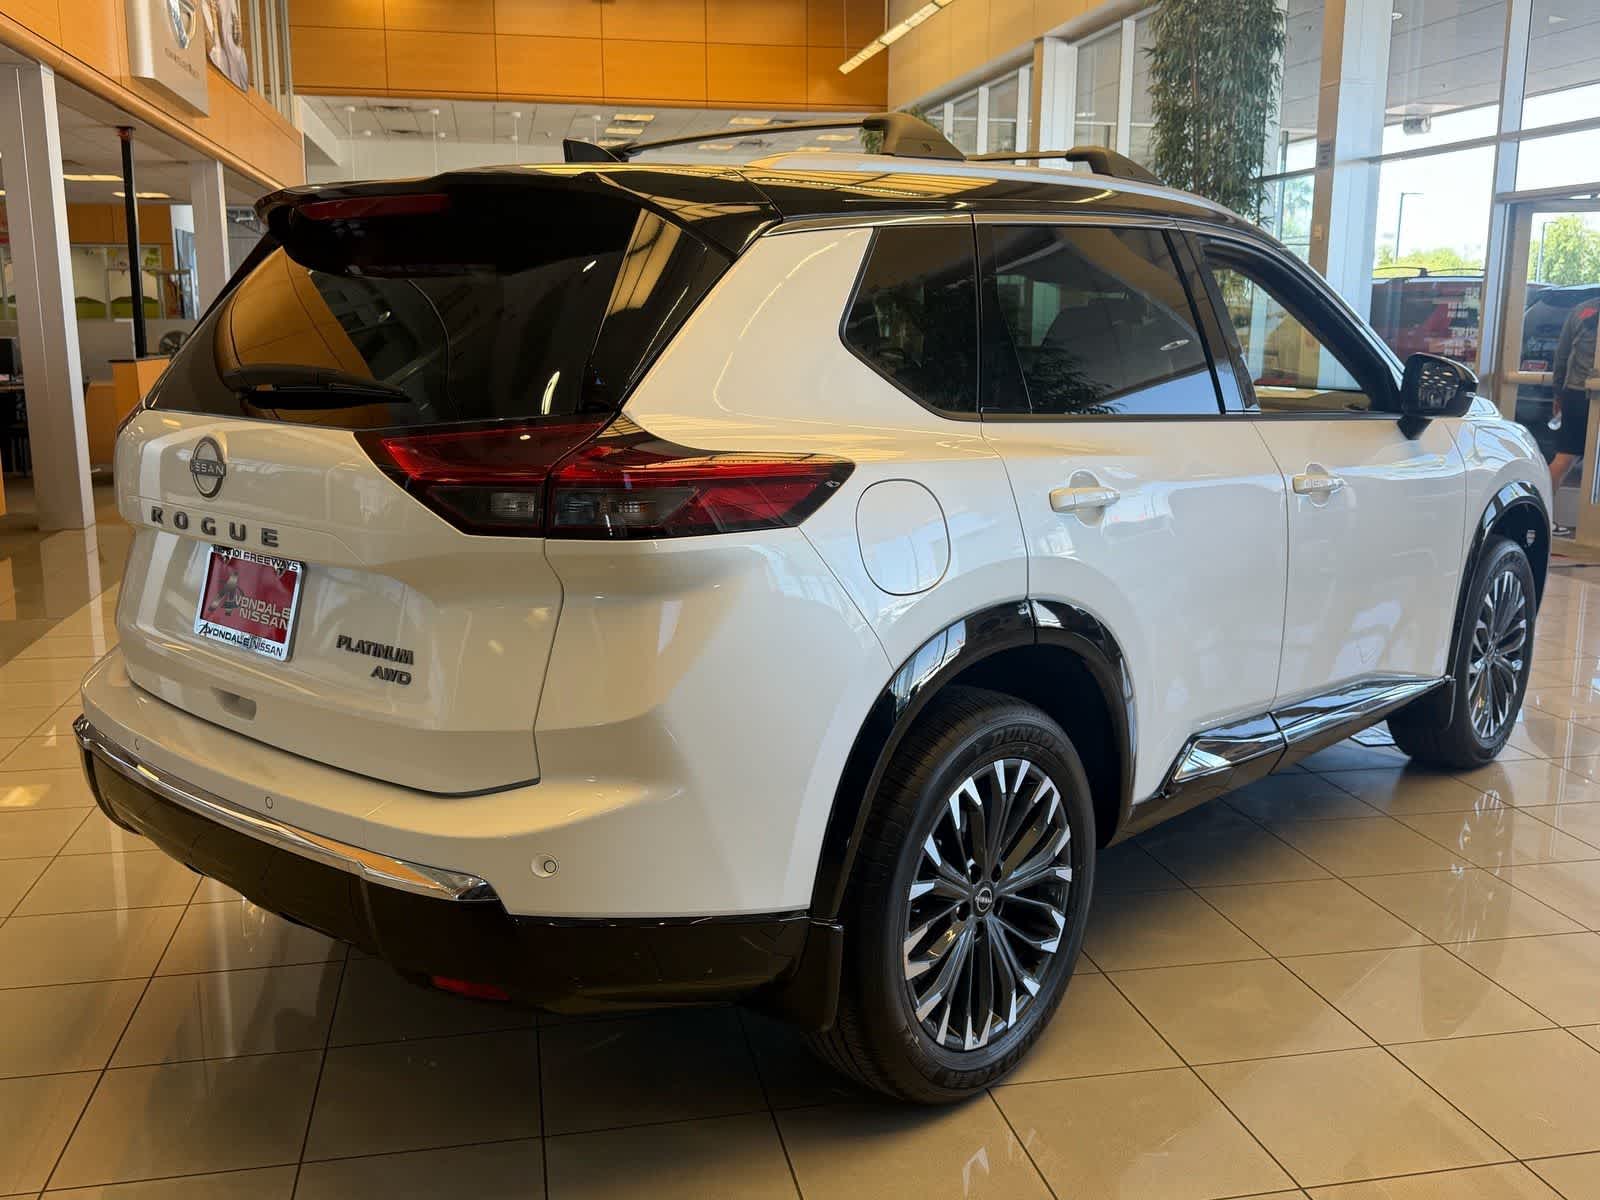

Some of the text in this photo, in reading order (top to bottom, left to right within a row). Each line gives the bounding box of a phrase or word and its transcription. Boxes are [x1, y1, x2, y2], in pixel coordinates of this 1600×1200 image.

[191, 461, 225, 476] SSAN
[151, 506, 279, 547] ROGUE
[243, 552, 299, 571] FREEWAYS
[239, 607, 289, 630] NISSAN
[250, 638, 283, 657] NISSAN
[336, 634, 414, 665] PLATINUM
[370, 665, 412, 685] AWD
